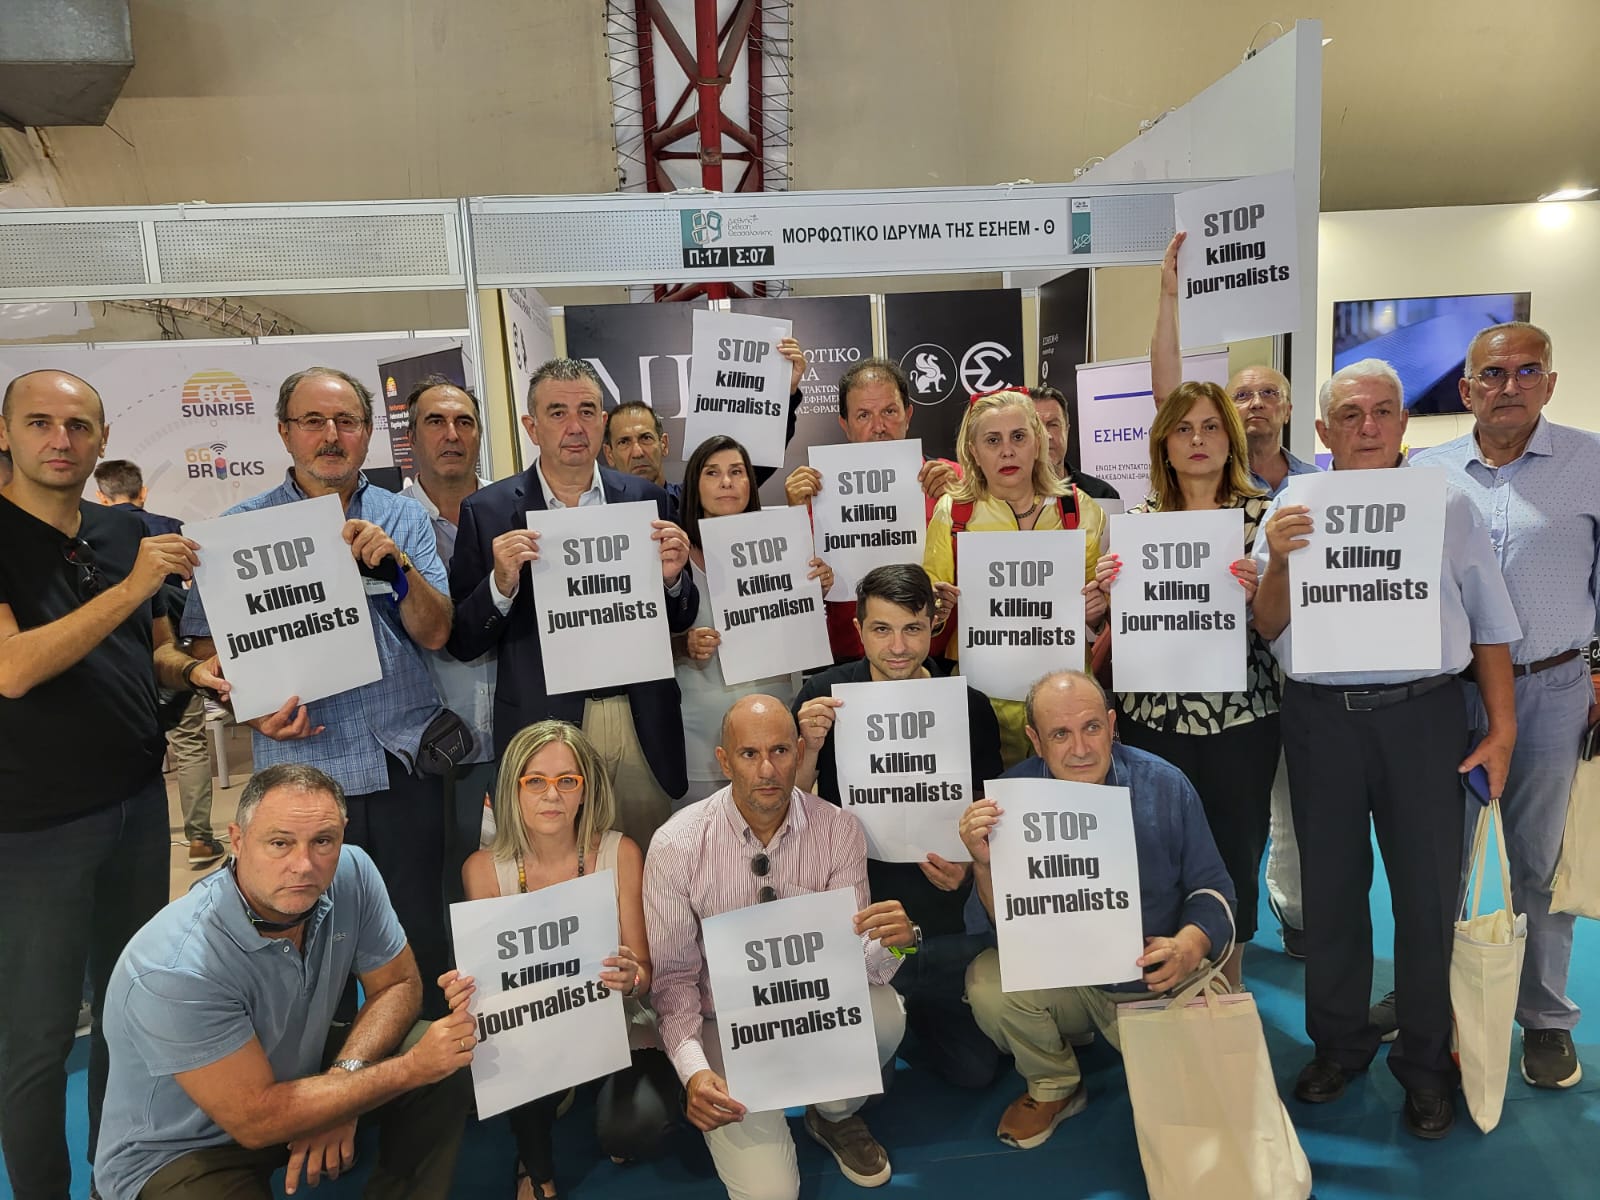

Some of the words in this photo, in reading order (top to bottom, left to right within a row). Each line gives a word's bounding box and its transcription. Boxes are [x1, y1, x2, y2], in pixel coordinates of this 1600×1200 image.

[782, 226, 878, 244] ΜΟΡΦΩΤΙΚΟ
[883, 223, 941, 240] ΙΔΡΥΜΑ
[945, 222, 974, 238] ΤΗΣ
[979, 220, 1030, 237] ΕΣΗΕΜ
[1043, 219, 1055, 235] Θ
[1204, 204, 1264, 237] STOP
[689, 249, 722, 265] Π:17
[735, 248, 767, 264] Σ:07
[1206, 241, 1265, 265] killing
[1186, 265, 1289, 299] journalists
[718, 338, 769, 363] STOP
[803, 347, 861, 363] ΩΤΙΚΟ
[716, 371, 764, 392] killing
[181, 402, 256, 418] SUNRISE
[694, 394, 781, 416] journalists
[184, 447, 212, 463] 6G
[838, 469, 895, 495] STOP
[841, 504, 896, 522] killing
[1326, 504, 1405, 534] STOP
[563, 535, 629, 565] STOP
[731, 537, 787, 567] STOP
[824, 529, 916, 552] journalism
[233, 537, 314, 580] STOP
[1143, 542, 1210, 569] STOP
[1326, 546, 1401, 570] killing
[567, 574, 631, 596] killing
[737, 574, 792, 596] killing
[989, 561, 1053, 587] STOP
[246, 582, 325, 616] killing
[1145, 581, 1209, 603] killing
[1301, 579, 1428, 607] journalists
[548, 601, 657, 633] journalists
[724, 597, 814, 631] journalism
[990, 598, 1052, 619] killing
[226, 606, 360, 660] journalists
[1120, 611, 1235, 634] journalists
[966, 627, 1075, 648] journalists
[867, 711, 935, 741] STOP
[870, 752, 936, 774] killing
[849, 782, 962, 805] journalists
[1023, 812, 1097, 842] STOP
[1028, 854, 1099, 879] killing
[1006, 888, 1129, 920] journalists
[496, 915, 580, 960] STOP
[745, 932, 824, 971] STOP
[501, 957, 580, 992] killing
[753, 979, 830, 1006] killing
[477, 979, 611, 1044] journalists
[731, 1007, 861, 1050] journalists
